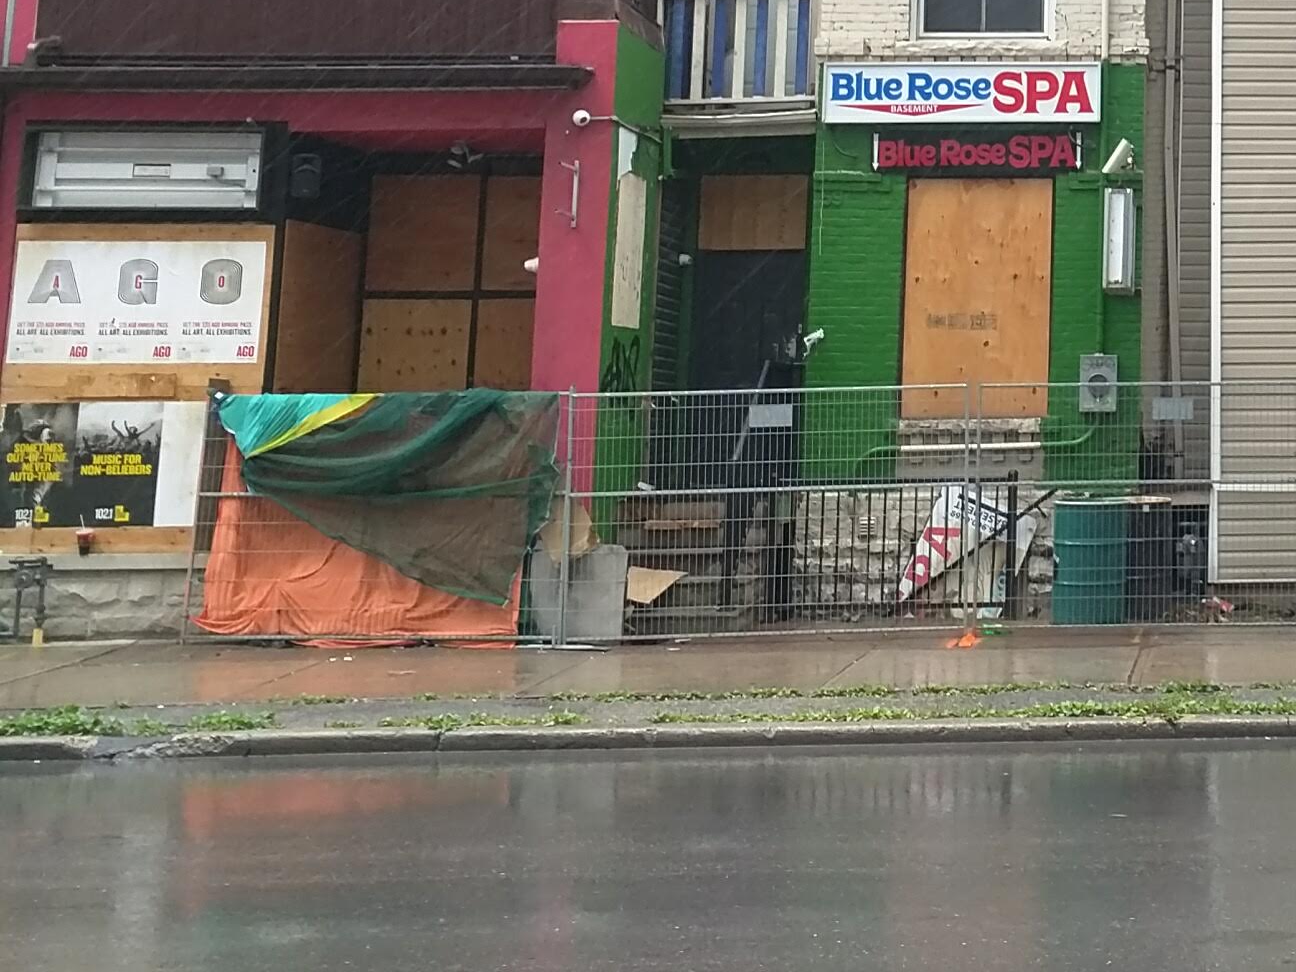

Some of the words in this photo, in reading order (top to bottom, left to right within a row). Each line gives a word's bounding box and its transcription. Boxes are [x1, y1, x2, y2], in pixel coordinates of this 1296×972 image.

[831, 72, 902, 101] Blue
[907, 72, 991, 101] Rose
[992, 71, 1094, 114] SPA
[890, 104, 938, 113] BASEMENT
[878, 139, 936, 168] Blue
[940, 139, 1005, 168] Rose
[1008, 135, 1077, 168] SPA
[27, 258, 81, 305] A
[117, 258, 159, 305] G
[200, 258, 243, 305] O
[69, 346, 88, 357] AGO
[153, 346, 171, 357] AGO
[236, 345, 255, 357] AGO
[14, 443, 64, 453] SOMETIMES
[92, 454, 122, 464] MUSIC
[123, 454, 142, 464] FOR
[22, 462, 52, 472] NEVER
